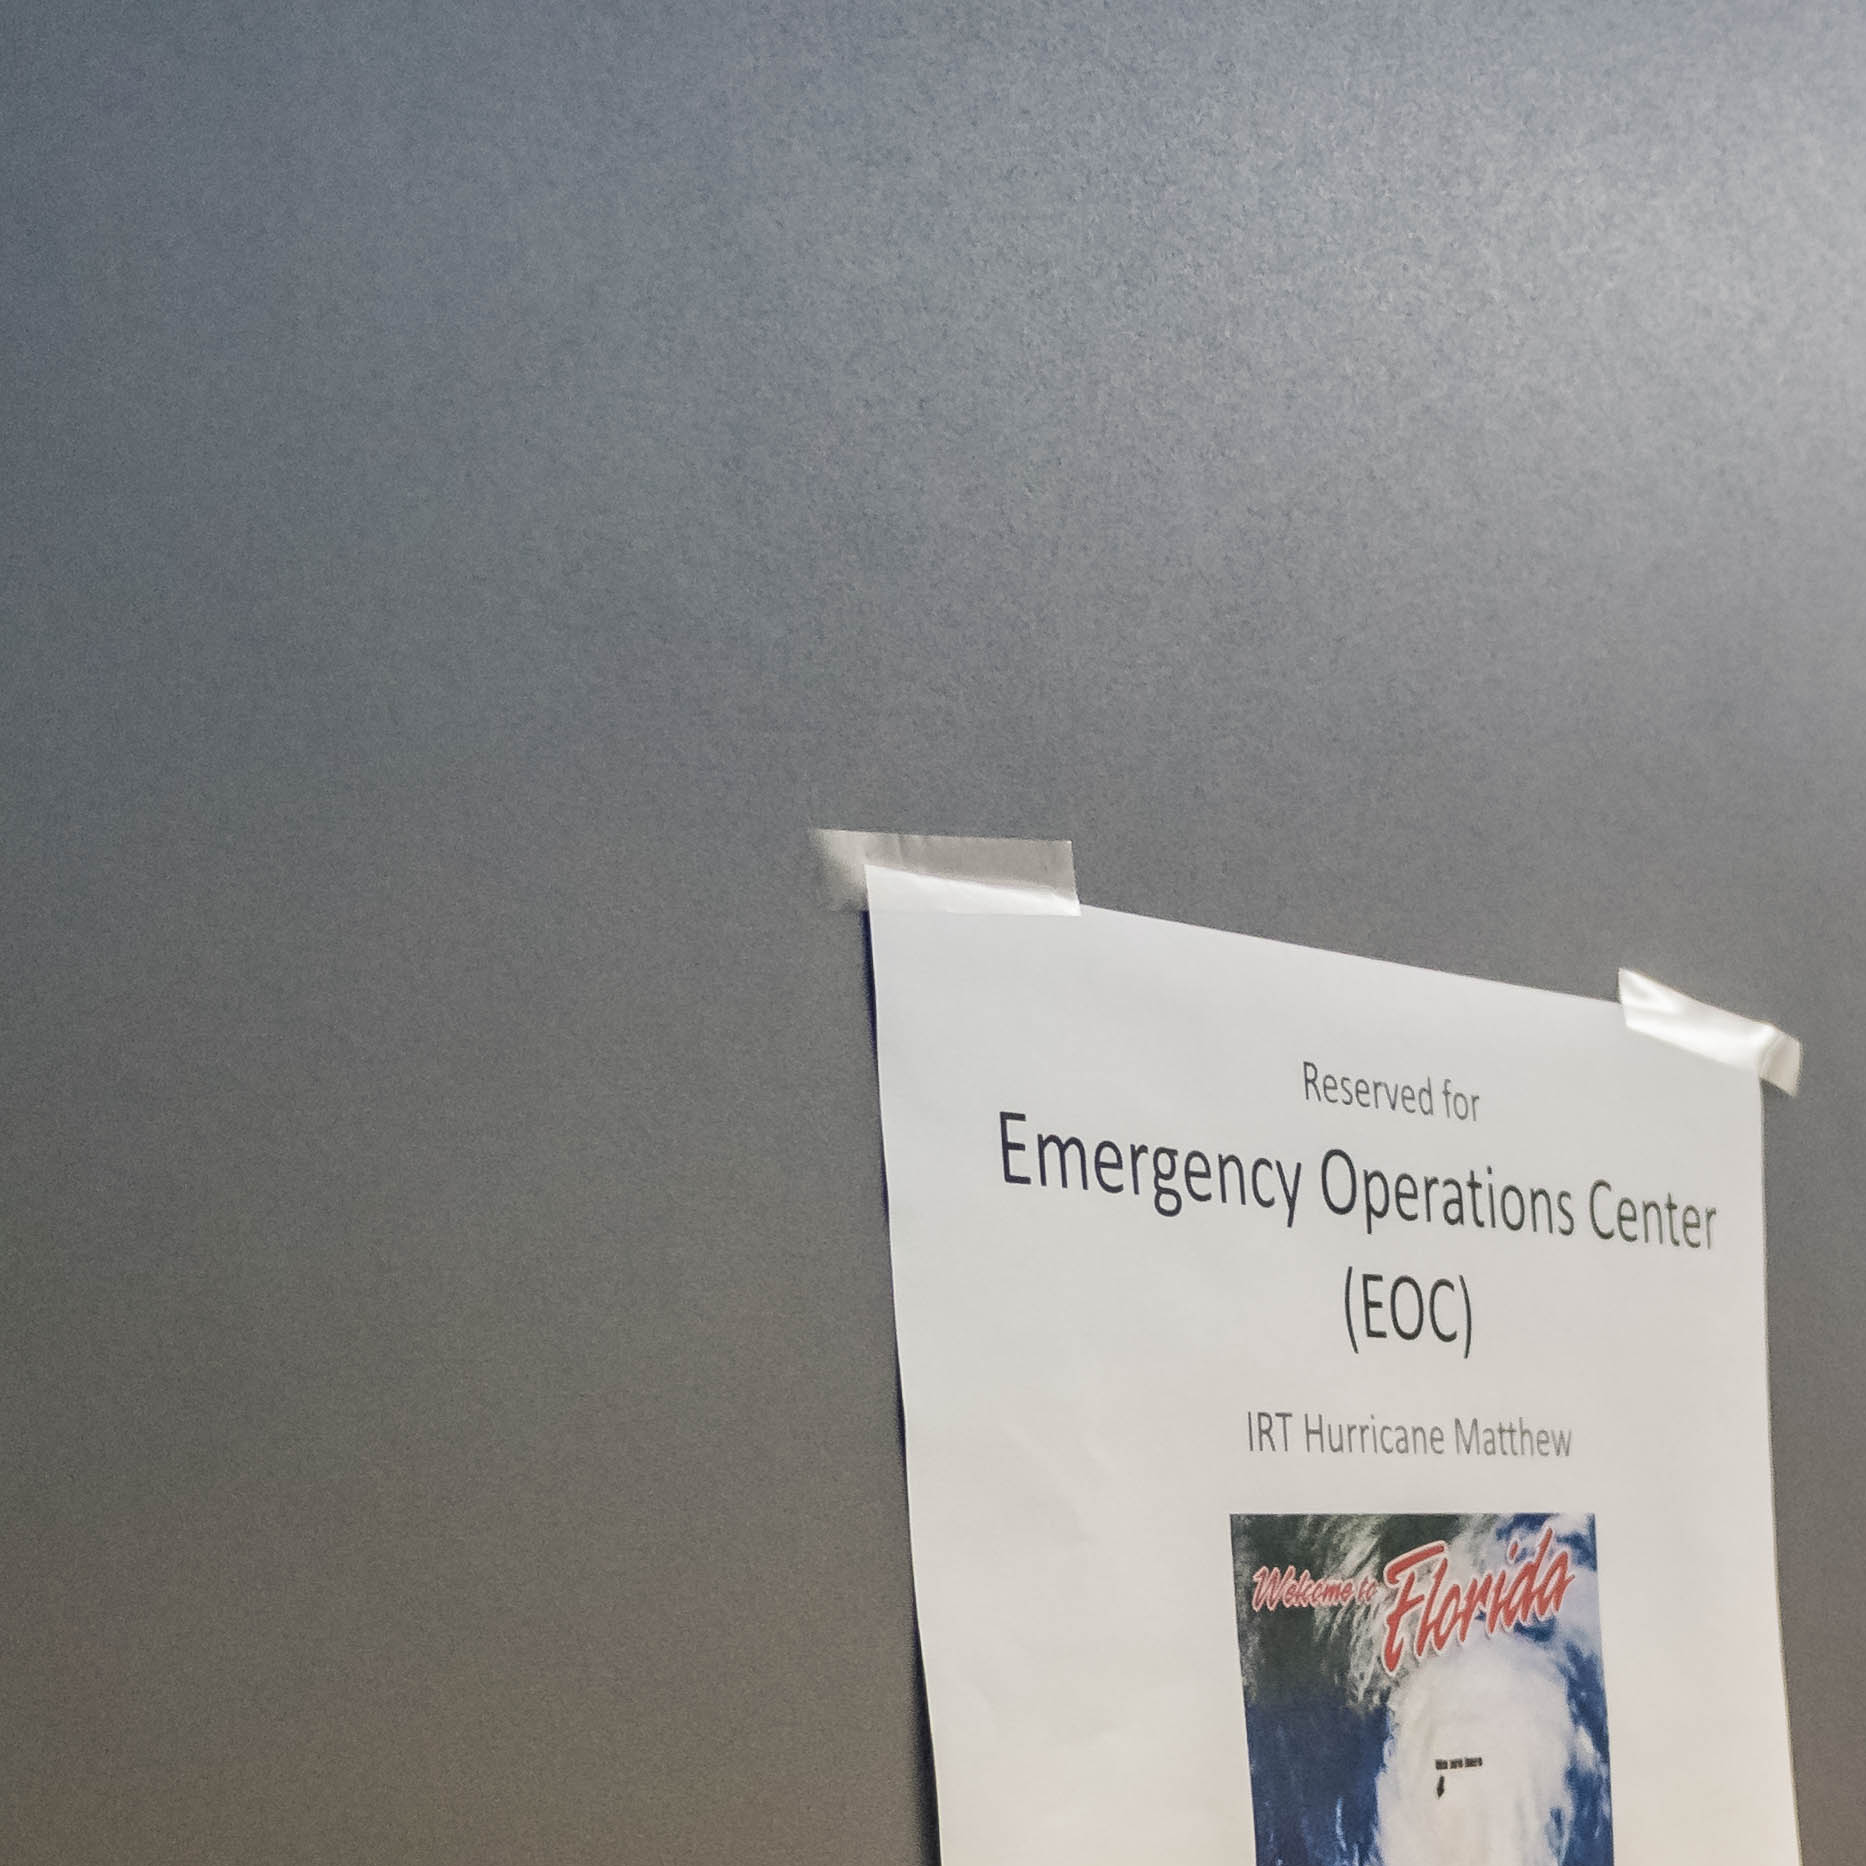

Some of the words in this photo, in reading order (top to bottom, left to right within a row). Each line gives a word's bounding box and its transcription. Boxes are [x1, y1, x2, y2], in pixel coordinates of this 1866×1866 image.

[1302, 1060, 1435, 1118] Reserved
[1441, 1083, 1481, 1122] for
[998, 1110, 1303, 1229] Emergency
[1320, 1148, 1575, 1237] Operations
[1588, 1178, 1718, 1250] Center
[1344, 1266, 1473, 1360] (EOC)
[1247, 1411, 1294, 1456] IRT
[1303, 1413, 1445, 1456] Hurricane
[1454, 1414, 1572, 1458] Matthew
[1252, 1565, 1354, 1613] Welcome
[1357, 1575, 1377, 1602] to
[1383, 1525, 1575, 1676] Florida
